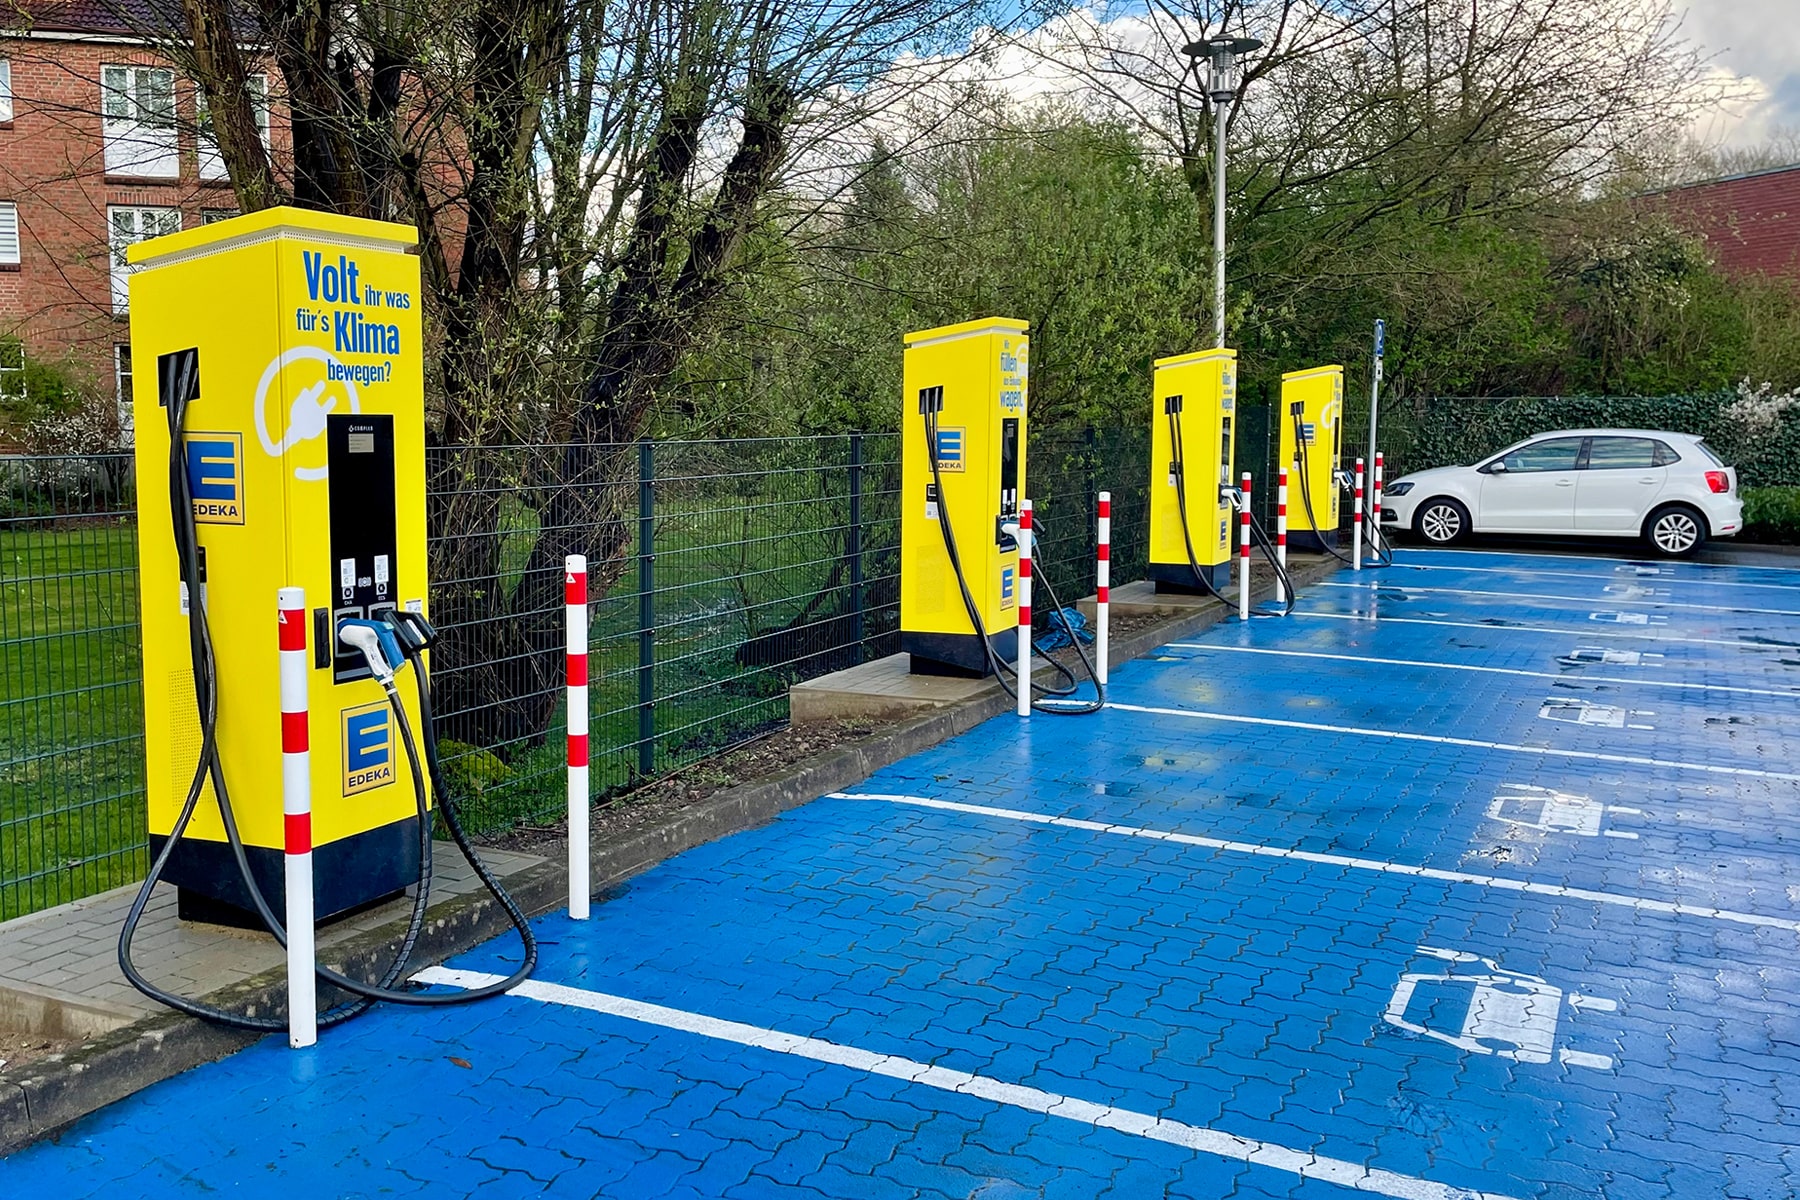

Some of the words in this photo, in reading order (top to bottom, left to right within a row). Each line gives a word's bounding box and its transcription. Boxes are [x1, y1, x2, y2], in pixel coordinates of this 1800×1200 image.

[303, 250, 360, 305] Volt
[365, 284, 382, 307] ihr
[385, 291, 410, 309] was
[334, 311, 400, 355] Klima
[327, 359, 392, 387] bewegen?
[187, 441, 236, 500] E
[347, 708, 389, 773] E
[348, 767, 391, 788] EDEKA
